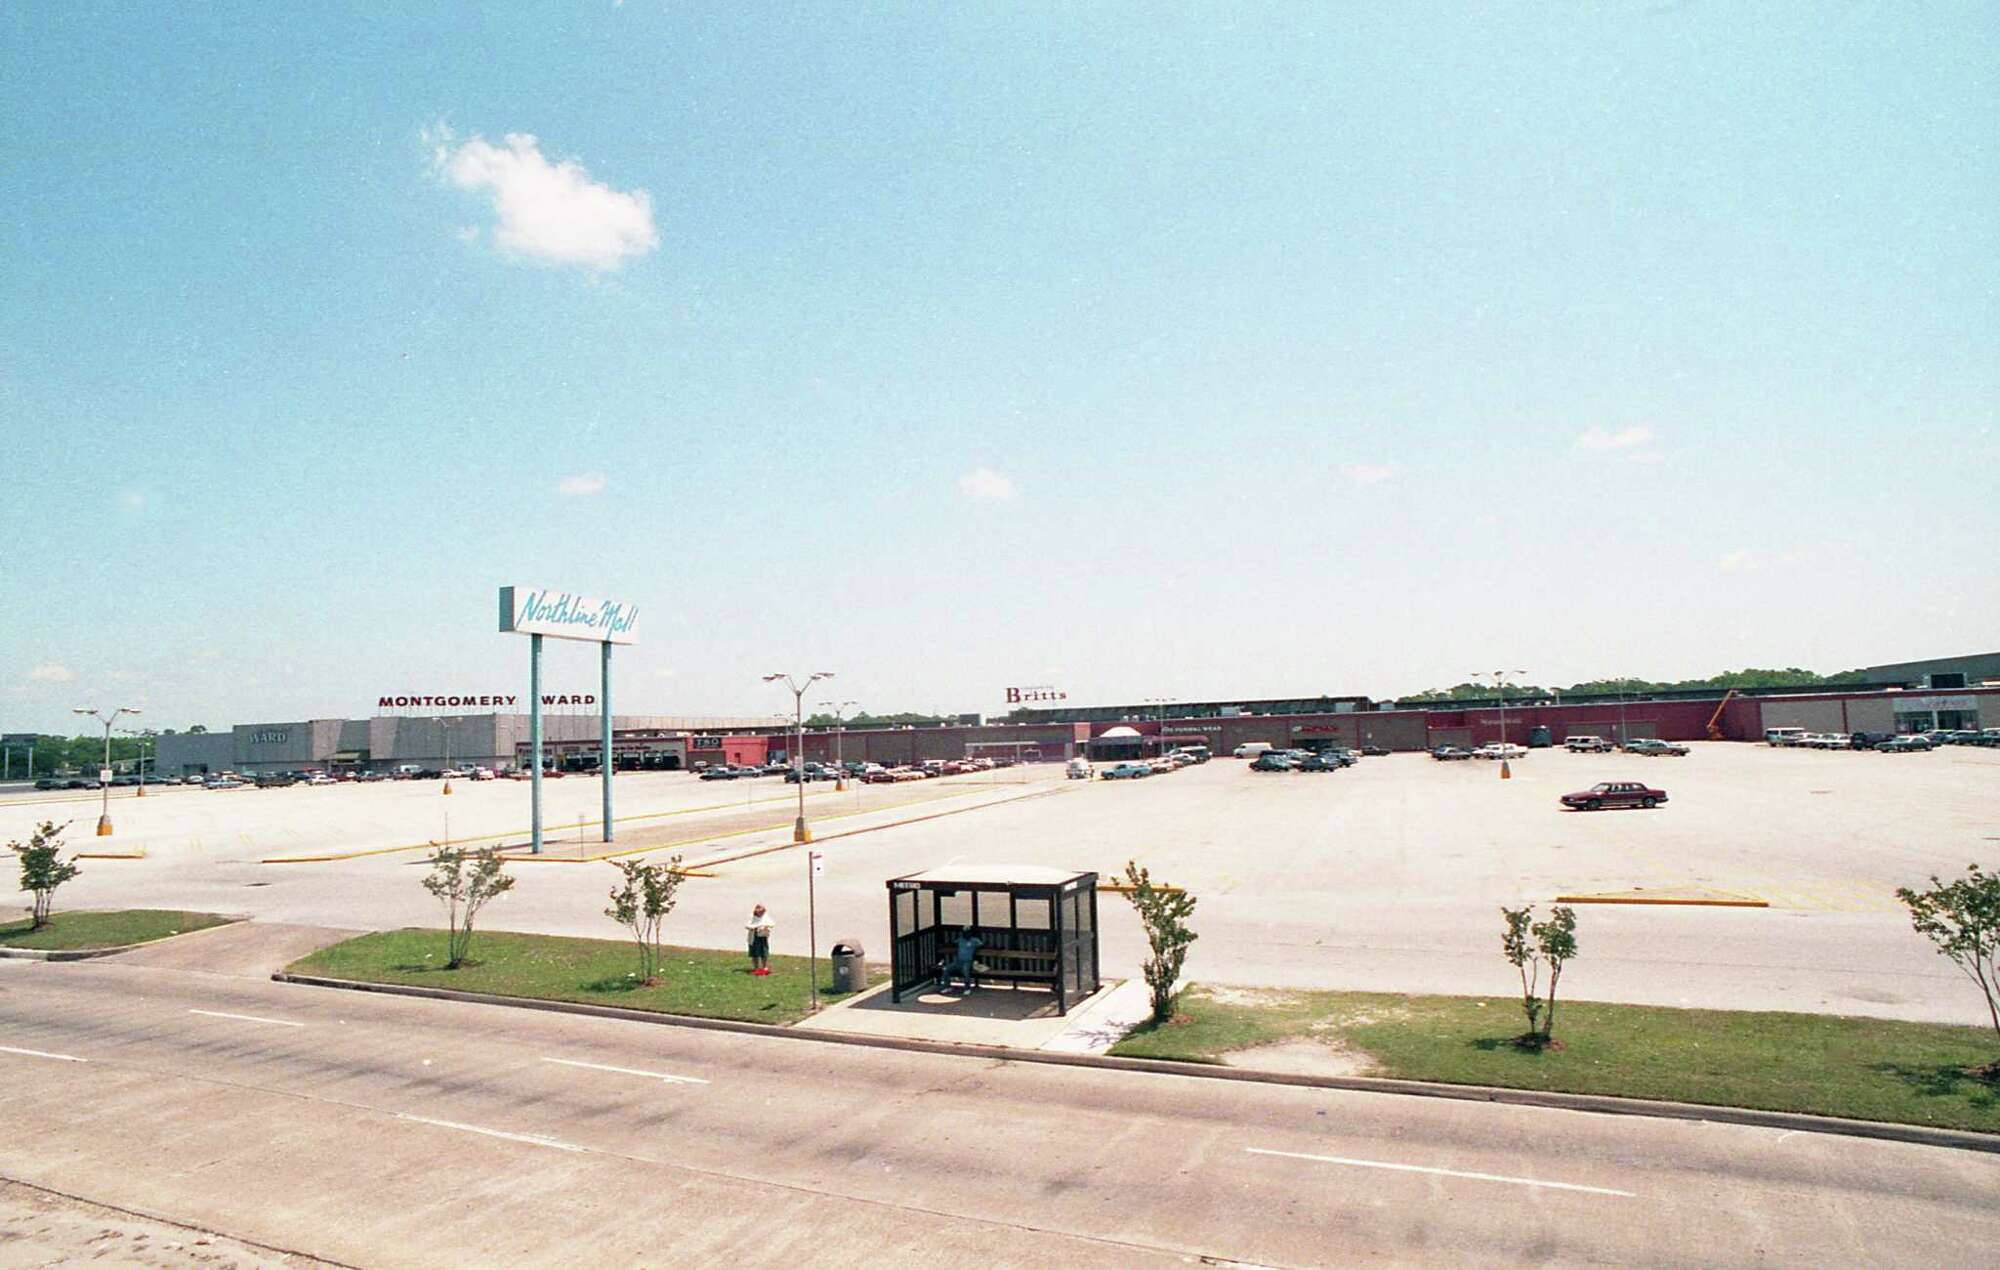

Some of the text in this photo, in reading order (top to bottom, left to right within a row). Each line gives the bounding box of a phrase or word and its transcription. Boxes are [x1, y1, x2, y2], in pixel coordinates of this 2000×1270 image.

[516, 590, 640, 640] Northline Mall
[378, 695, 596, 707] MONTGOMERY WARD
[1006, 687, 1067, 703] Britts
[249, 731, 288, 744] WARD
